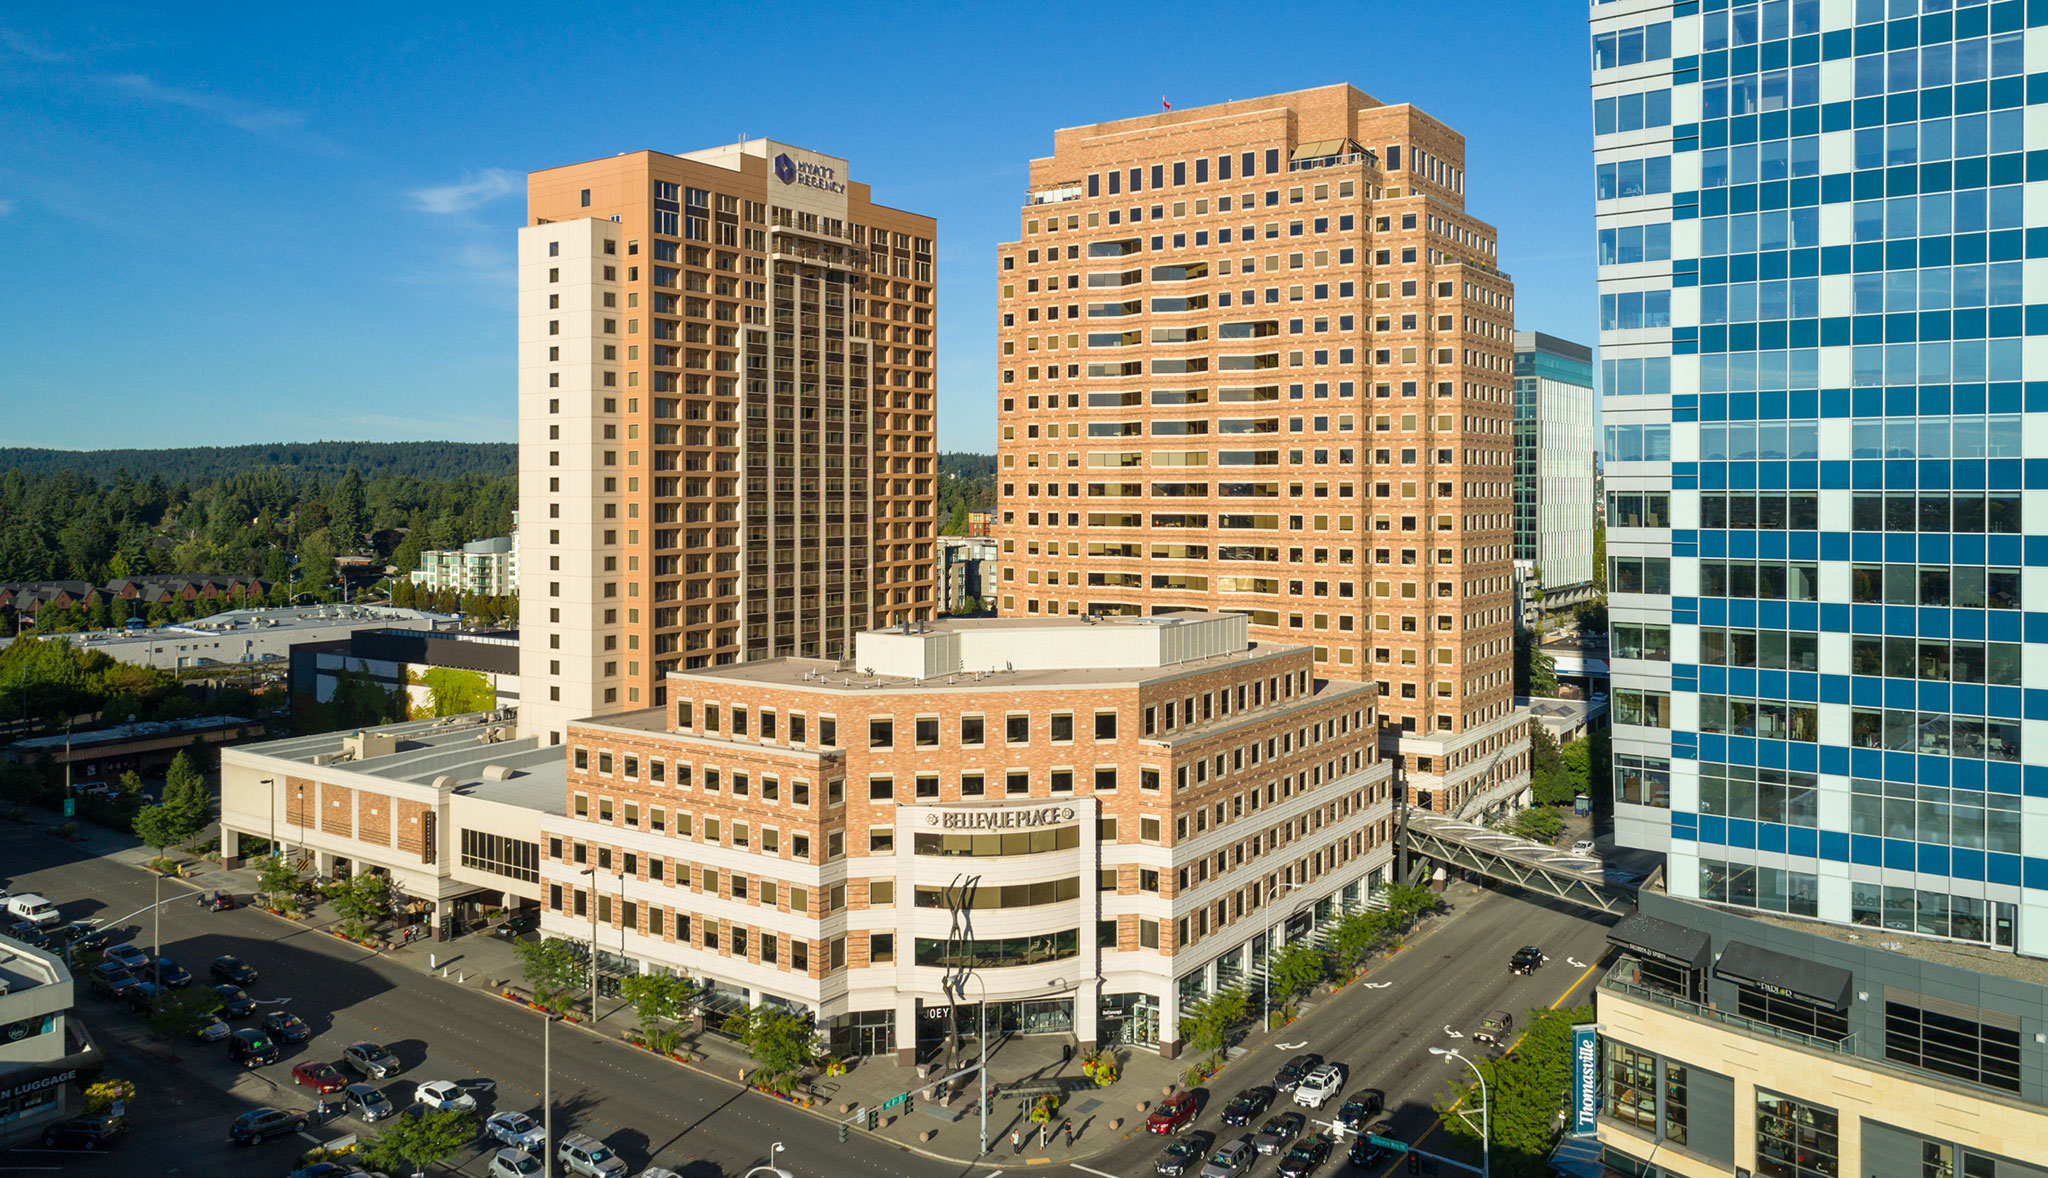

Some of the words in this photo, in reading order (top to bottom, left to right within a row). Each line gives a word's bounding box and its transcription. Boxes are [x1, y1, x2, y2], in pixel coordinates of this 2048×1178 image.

[797, 160, 835, 180] HYATT
[797, 173, 845, 194] REGENCY
[942, 811, 1014, 829] BELLEVUE
[1016, 807, 1061, 827] PLACE
[1760, 982, 1793, 999] PARLOR
[923, 1007, 949, 1019] JOEY
[14, 1069, 77, 1096] LUGGAGE
[1578, 1039, 1594, 1126] Thomasville
